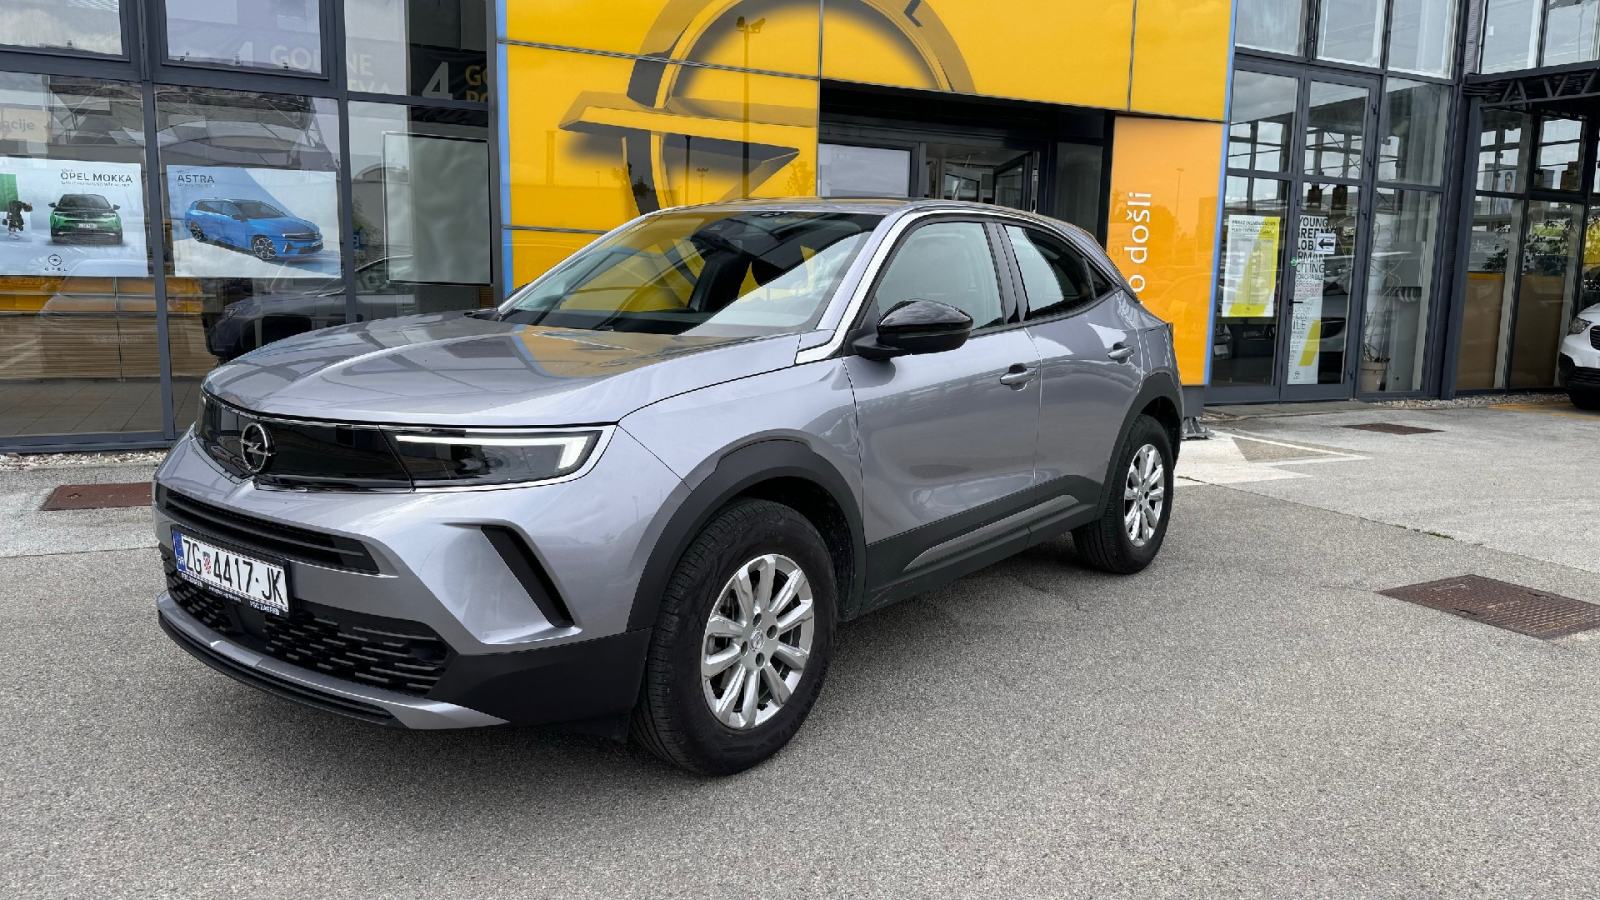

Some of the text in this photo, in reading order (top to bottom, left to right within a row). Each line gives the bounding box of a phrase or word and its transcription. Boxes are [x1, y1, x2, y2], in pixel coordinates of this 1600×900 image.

[422, 61, 453, 100] 4
[60, 172, 133, 183] OPEL MOKKA
[177, 174, 215, 184] ASTRA
[1123, 191, 1152, 264] došli
[183, 538, 202, 575] ZG
